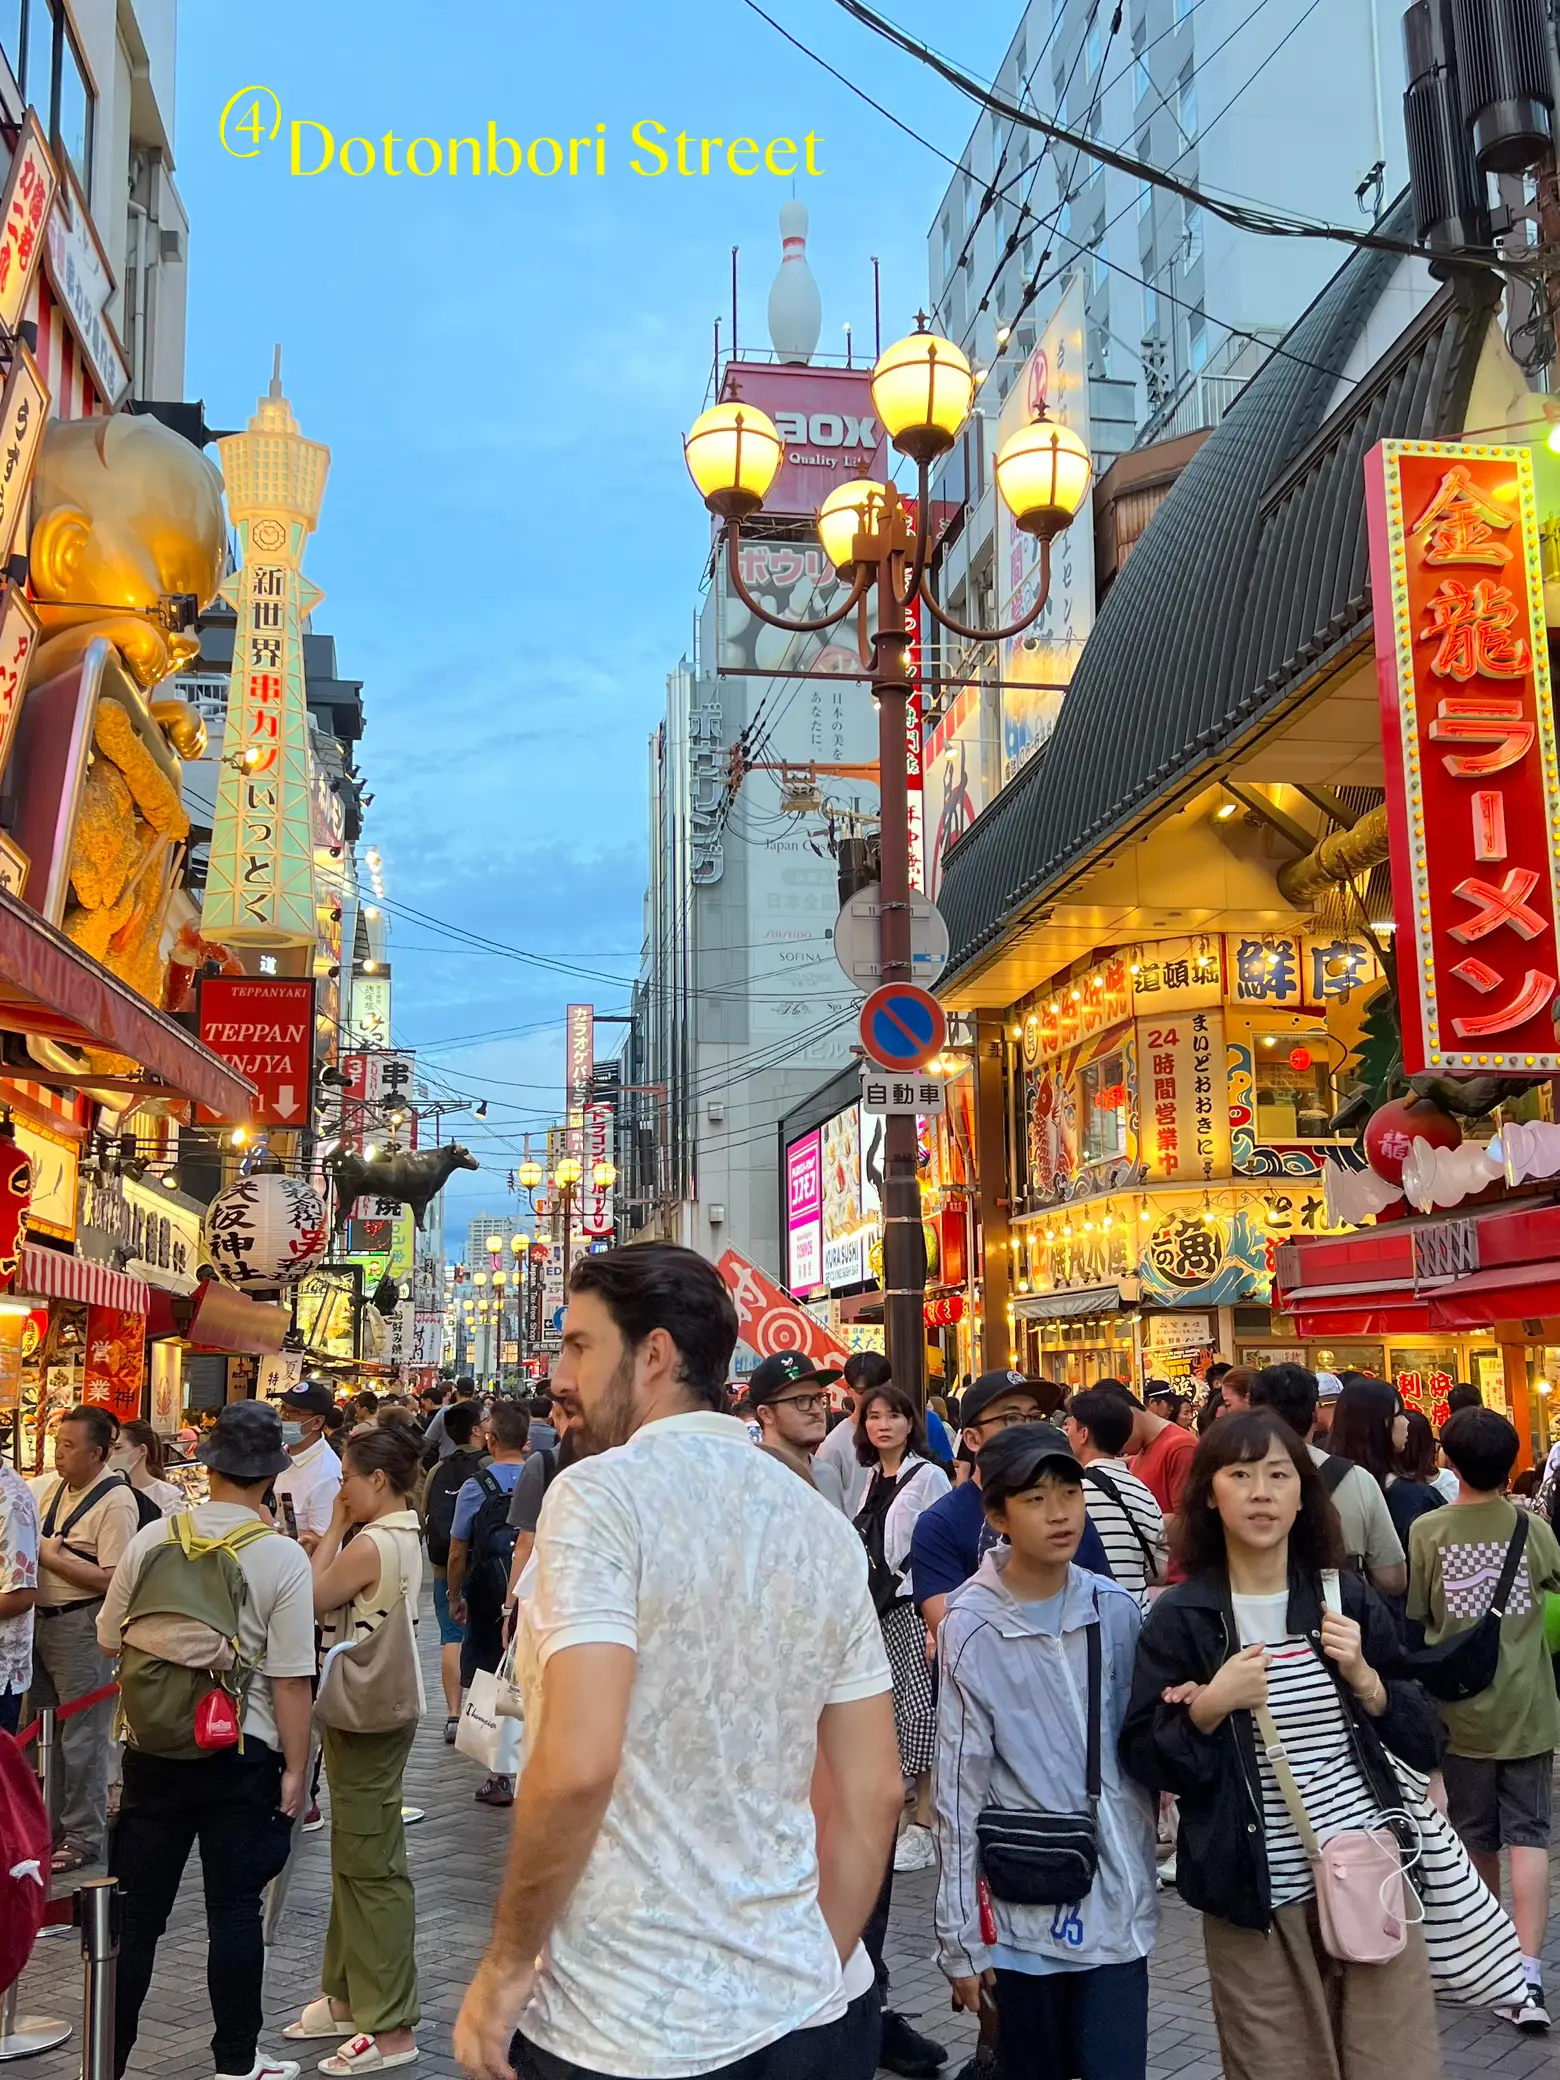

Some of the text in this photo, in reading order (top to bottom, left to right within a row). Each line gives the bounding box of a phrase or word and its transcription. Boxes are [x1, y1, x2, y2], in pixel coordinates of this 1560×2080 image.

[775, 412, 877, 448] aox
[789, 452, 838, 469] Quality
[810, 691, 824, 753] あなたに。
[831, 692, 844, 761] 日本の美を
[1411, 464, 1556, 1039] 金龍ラーメン
[765, 839, 799, 854] Japan
[779, 952, 822, 962] SOFINA
[1237, 938, 1368, 1000] 鮮度
[1134, 955, 1220, 994] 道頓堀
[231, 986, 307, 998] TEPPANYAKI
[205, 1023, 306, 1043] TEPPAN
[867, 1083, 940, 1105] 自動車
[1192, 1014, 1214, 1156] まいどおおきに
[1147, 1028, 1181, 1177] 24時間営業中
[841, 1239, 860, 1265] SUSHI
[529, 1263, 537, 1288] Japan.
[529, 1321, 537, 1341] Shop
[88, 1340, 113, 1402] 営業
